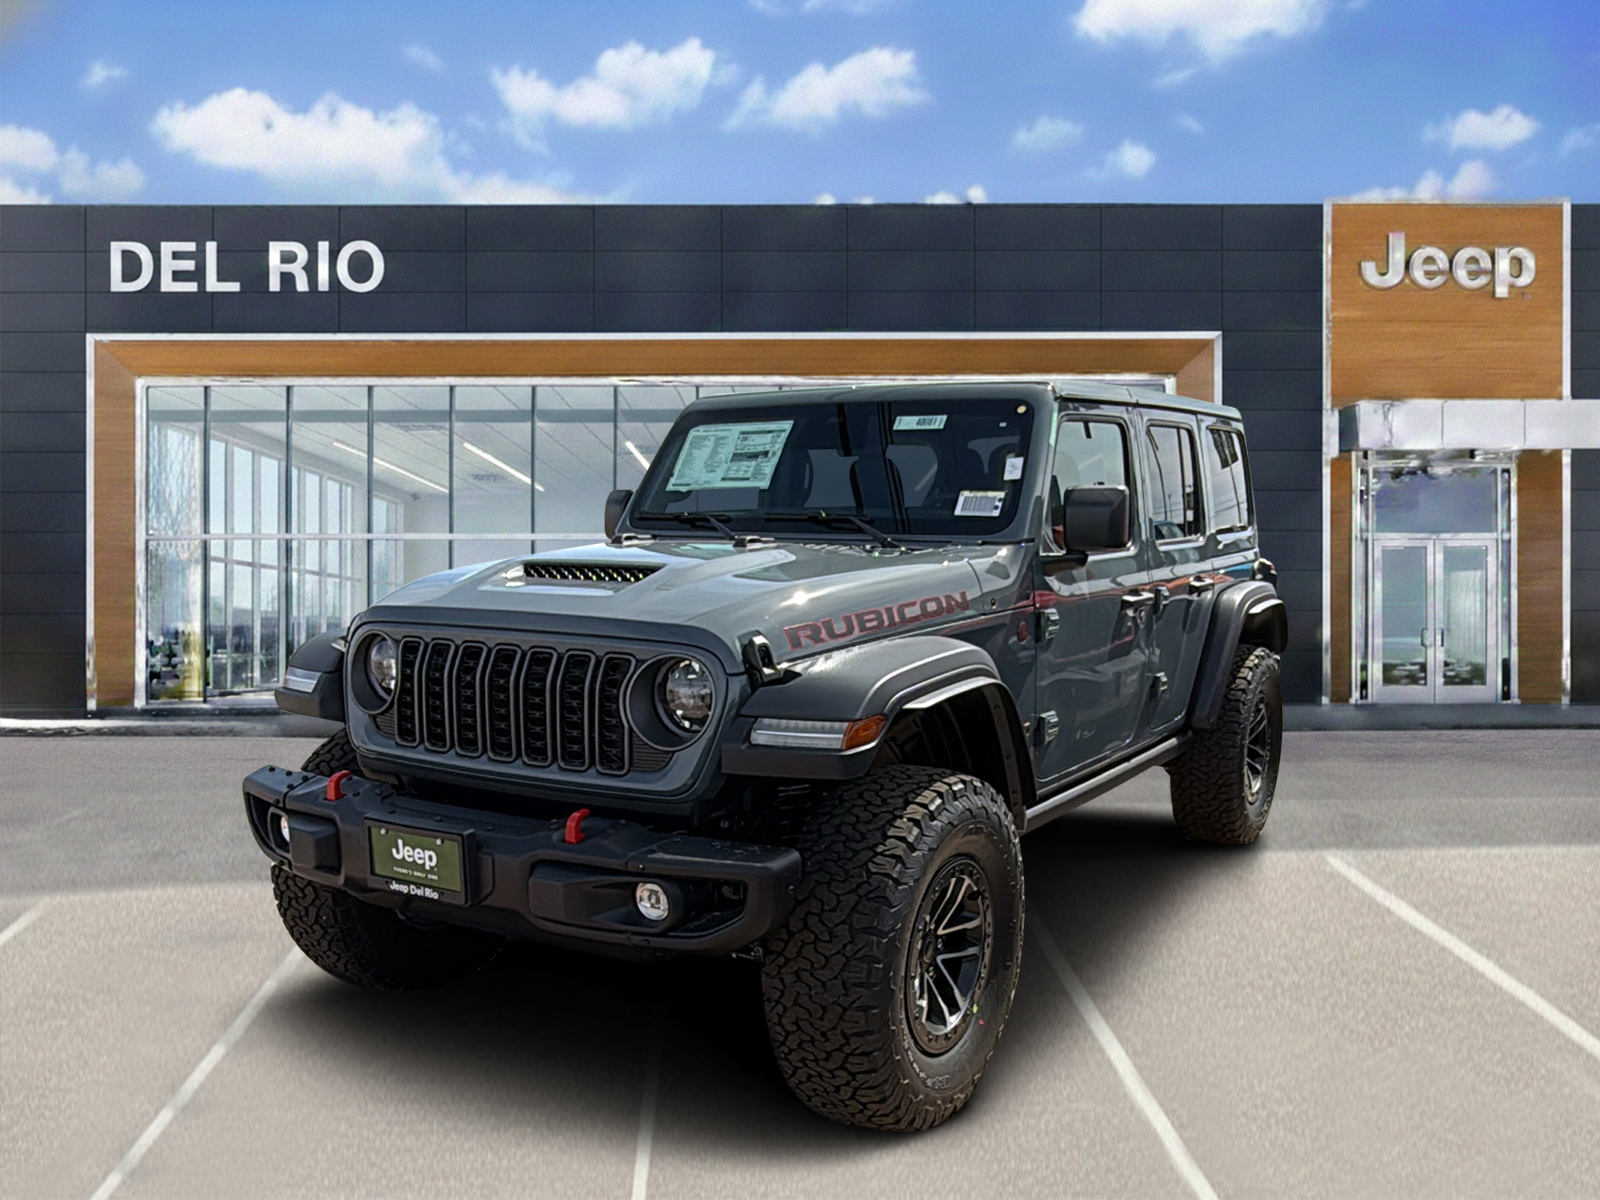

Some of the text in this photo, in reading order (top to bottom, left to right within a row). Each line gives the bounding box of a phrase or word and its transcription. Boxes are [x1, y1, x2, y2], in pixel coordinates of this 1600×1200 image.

[110, 240, 385, 293] DEL RIO
[1361, 231, 1536, 298] Jeep
[783, 590, 970, 650] RUBICON
[391, 838, 437, 870] Jeep
[389, 880, 439, 900] Jeep Del Rio
